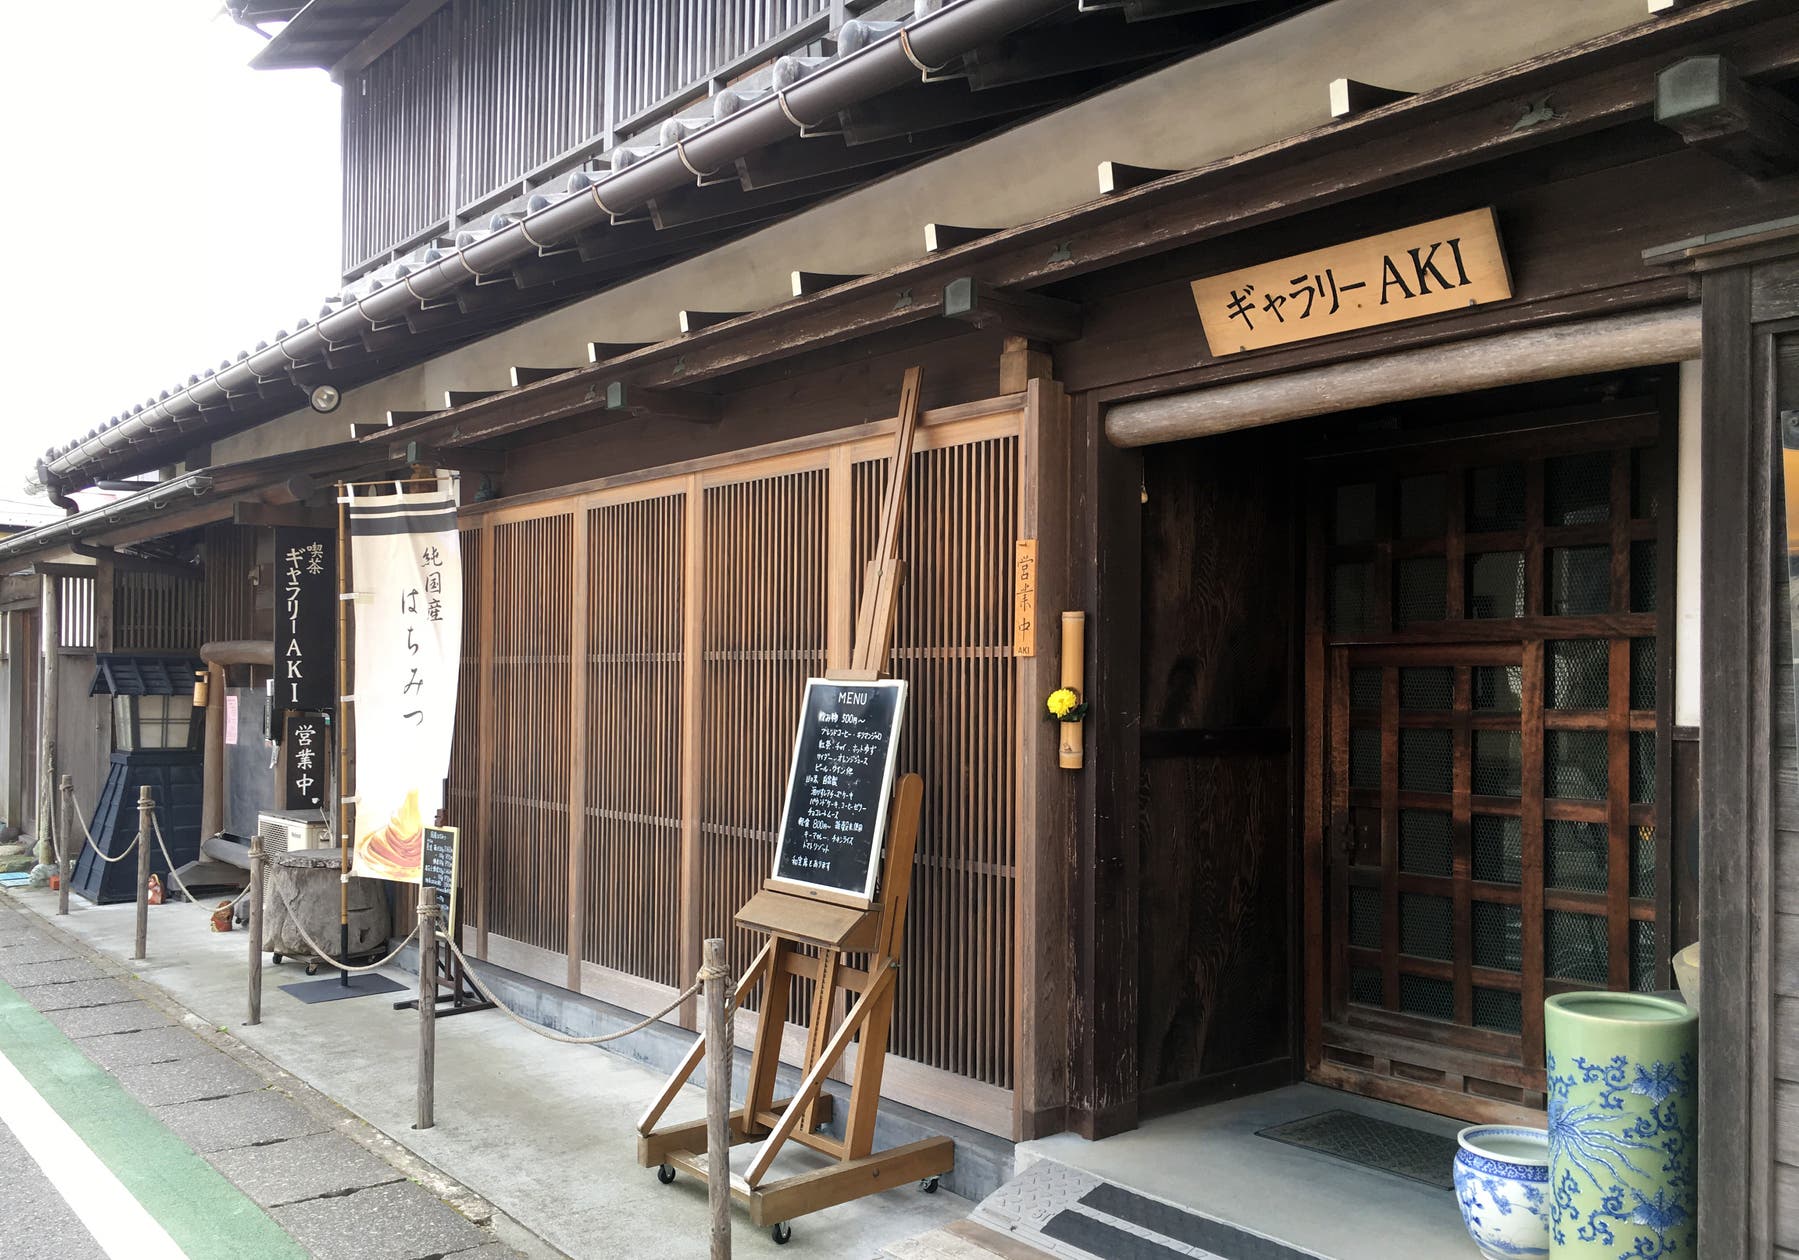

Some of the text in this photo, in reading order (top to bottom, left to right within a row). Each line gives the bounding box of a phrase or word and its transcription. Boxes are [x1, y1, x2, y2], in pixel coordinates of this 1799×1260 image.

[1379, 237, 1473, 306] AKI
[305, 541, 325, 575] 喫茶
[421, 546, 444, 622] 純国産
[401, 587, 425, 727] はちみつ
[1017, 646, 1030, 655] AKI
[838, 691, 868, 706] MENU
[294, 724, 317, 797] 営業中
